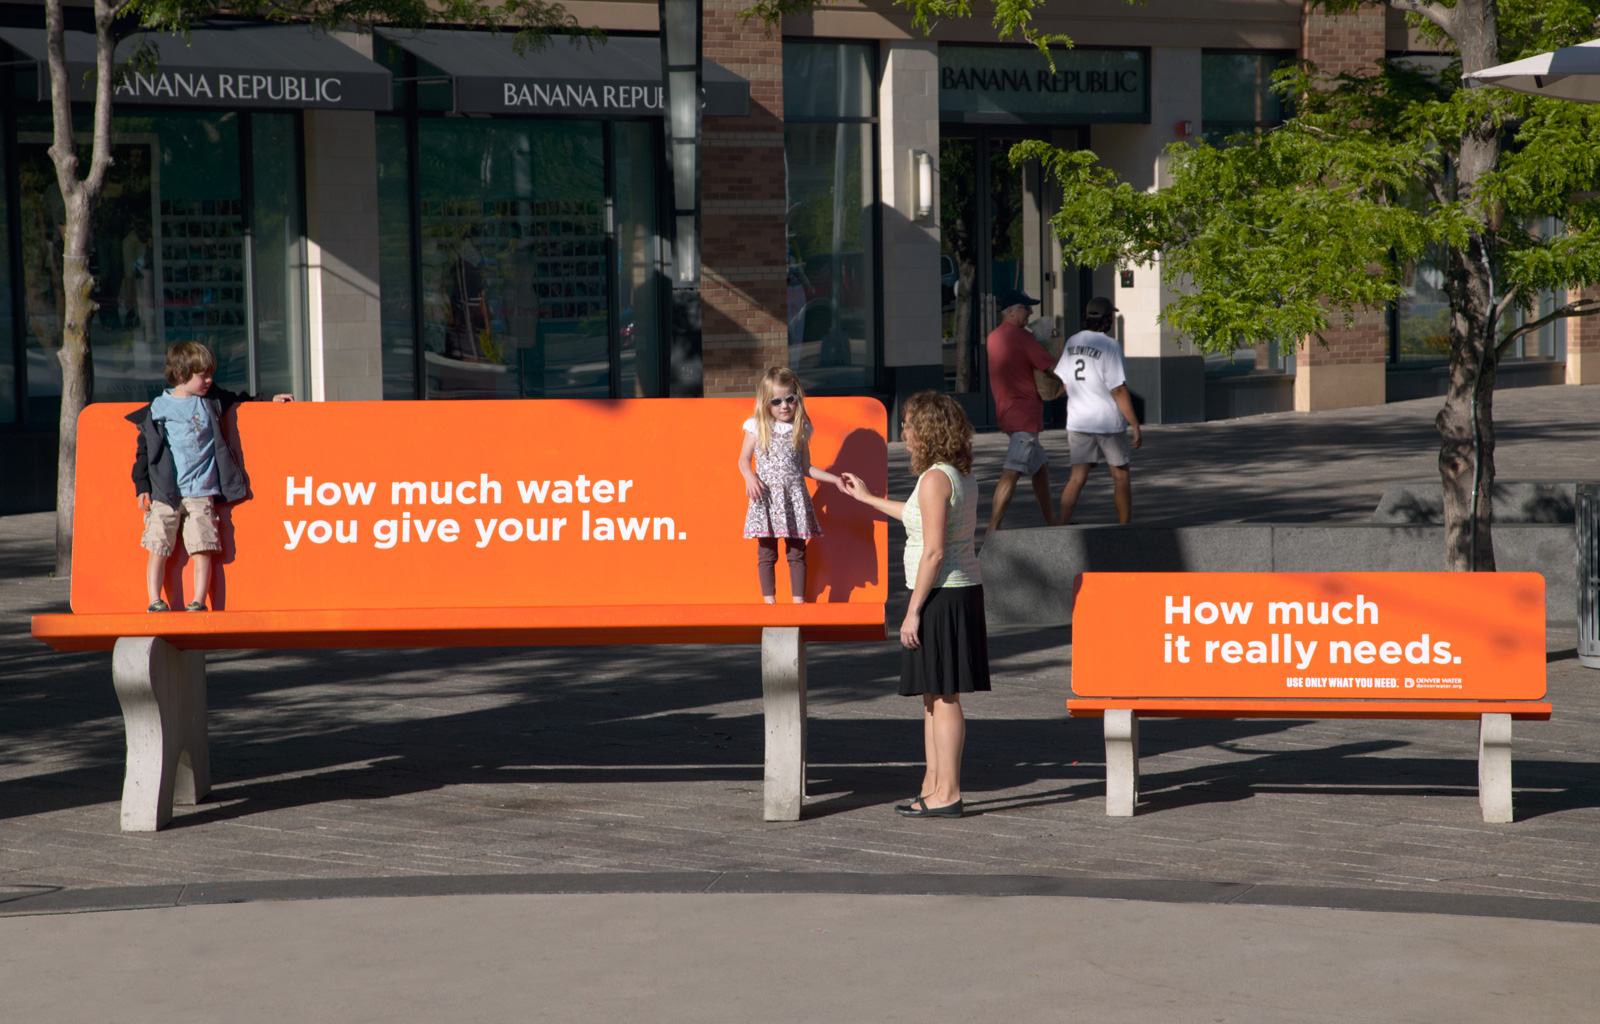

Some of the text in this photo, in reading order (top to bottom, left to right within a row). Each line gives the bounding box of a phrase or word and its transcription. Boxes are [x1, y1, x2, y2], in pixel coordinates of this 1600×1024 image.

[114, 72, 342, 102] ANANA REPUBLIC
[504, 83, 598, 107] BANANA
[942, 67, 1138, 93] BANANA REPUBLIC
[1074, 359, 1085, 381] 2
[286, 473, 634, 506] How much water
[283, 509, 687, 551] you give your lawn.
[1164, 594, 1379, 625] How much
[1164, 633, 1462, 670] it really needs.
[1286, 677, 1400, 689] USE ONLY WHAT YOU NEED.
